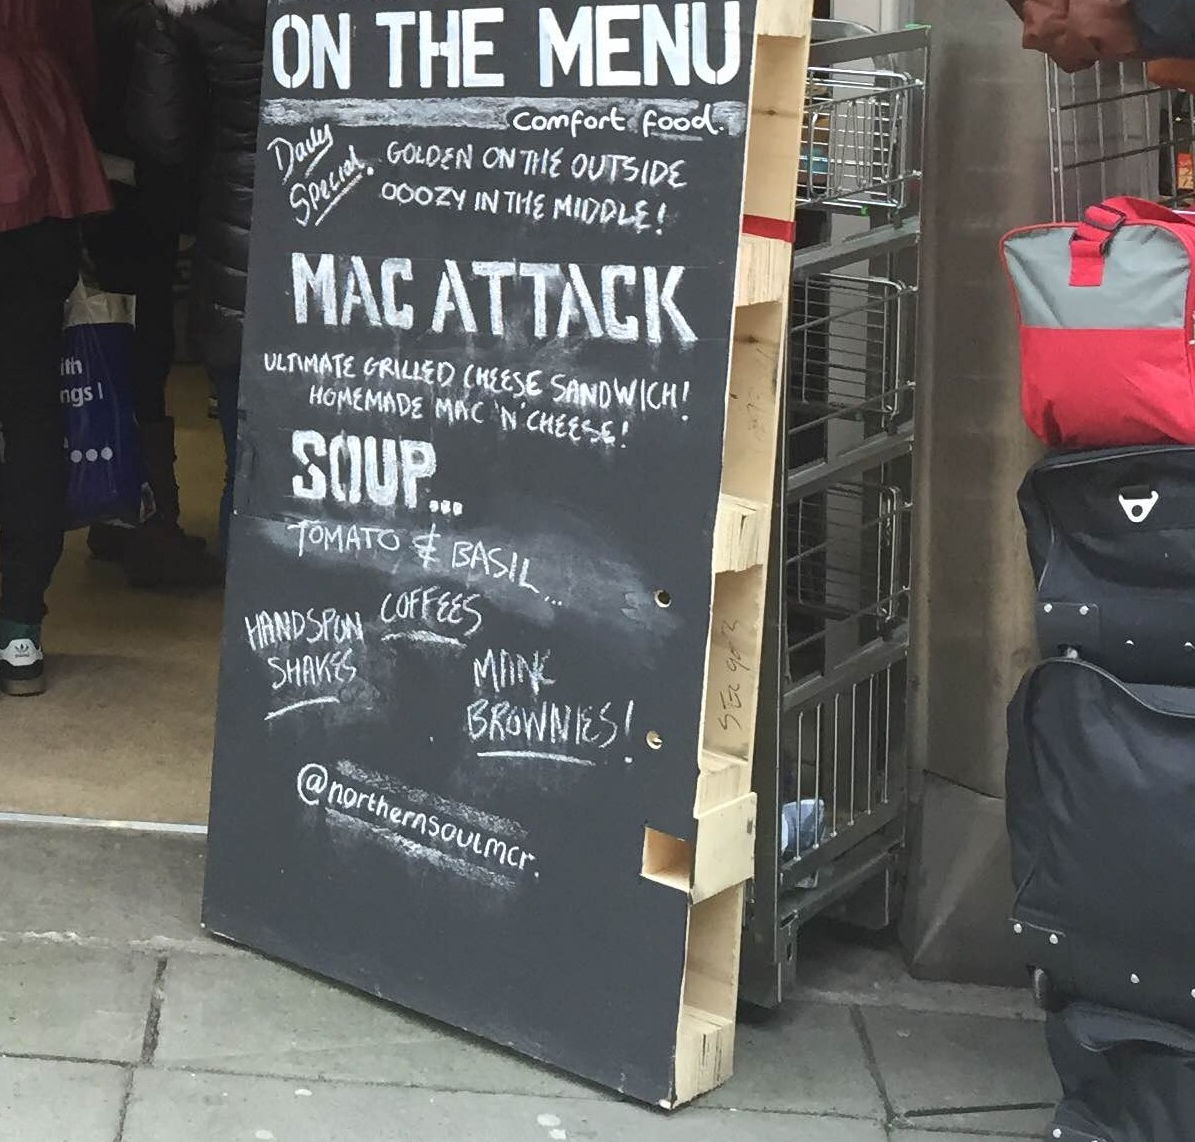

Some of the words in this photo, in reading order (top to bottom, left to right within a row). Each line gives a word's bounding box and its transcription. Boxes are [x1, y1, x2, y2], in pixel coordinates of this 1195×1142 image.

[271, 12, 352, 90] ON
[375, 7, 506, 89] THE
[538, 0, 741, 89] MENU
[640, 105, 726, 140] food.
[386, 140, 474, 172] GOLDEN
[482, 144, 517, 171] ON
[521, 146, 565, 179] THE
[570, 151, 688, 189] OUTSIDE
[473, 188, 502, 216] IN
[503, 189, 547, 221] THE
[552, 194, 667, 236] MIDDLE!
[291, 252, 415, 329] MAC
[431, 259, 699, 345] ATTACK
[263, 352, 356, 381] ULTIMATE
[363, 357, 457, 388] GRILLED
[462, 363, 545, 399] CHEESE
[550, 372, 692, 422] SANDWICH!
[308, 384, 426, 421] HOMEMADE
[434, 398, 486, 425] MAC
[526, 408, 630, 450] CHEESE!
[288, 519, 400, 557] TOMATO
[411, 523, 440, 569] &
[244, 607, 364, 651] HANDSPUN
[380, 585, 482, 636] COFFEES
[267, 648, 357, 690] SHAKES
[466, 699, 636, 765] BROWNIES!
